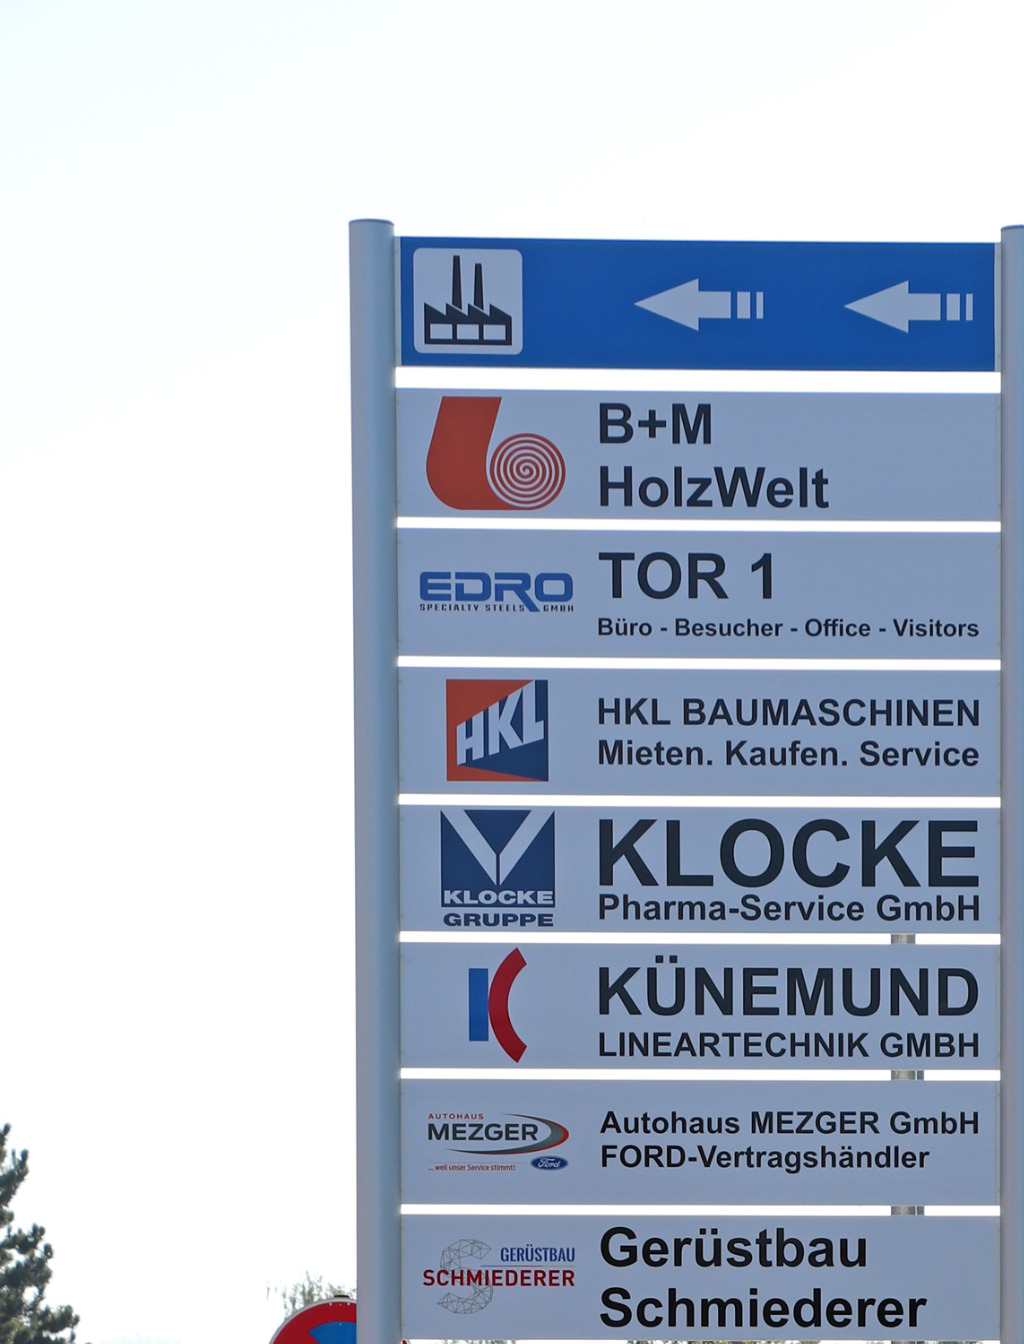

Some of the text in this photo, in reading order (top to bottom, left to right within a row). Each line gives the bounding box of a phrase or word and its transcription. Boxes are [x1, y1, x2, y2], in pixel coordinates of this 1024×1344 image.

[600, 403, 711, 444] B+M
[600, 466, 829, 509] HolzWelt
[599, 552, 772, 599] TOR 1
[419, 571, 574, 612] EDRO
[419, 603, 575, 612] SPECIALTY STEELS GMBH
[598, 618, 652, 636] Büro
[675, 618, 783, 637] Besucher
[805, 618, 870, 637] Office
[893, 619, 979, 637] Visitors
[455, 679, 545, 766] HKL
[599, 698, 979, 726] HKL BAUMASCHINEN
[599, 740, 979, 766] Mieten. Kaufen. Service
[599, 819, 979, 888] KLOCKE
[442, 890, 554, 905] KLOCKE
[599, 894, 979, 921] Pharma-Service GmbH
[443, 913, 553, 927] GRUPPE
[599, 955, 978, 1017] KÜNEMUND
[599, 1032, 978, 1057] LINEARTECHNIK GMBH
[428, 1123, 539, 1141] MEZGER
[600, 1111, 978, 1134] Autohaus MEZGER GmbH
[538, 1158, 562, 1168] Ford
[602, 1145, 930, 1174] FORD-Vertragshändler
[501, 1244, 575, 1262] GERÜSTBAU
[600, 1227, 866, 1267] Gerüstbau
[423, 1269, 575, 1287] SCHMIEDERER
[600, 1287, 927, 1328] Schmiederer
